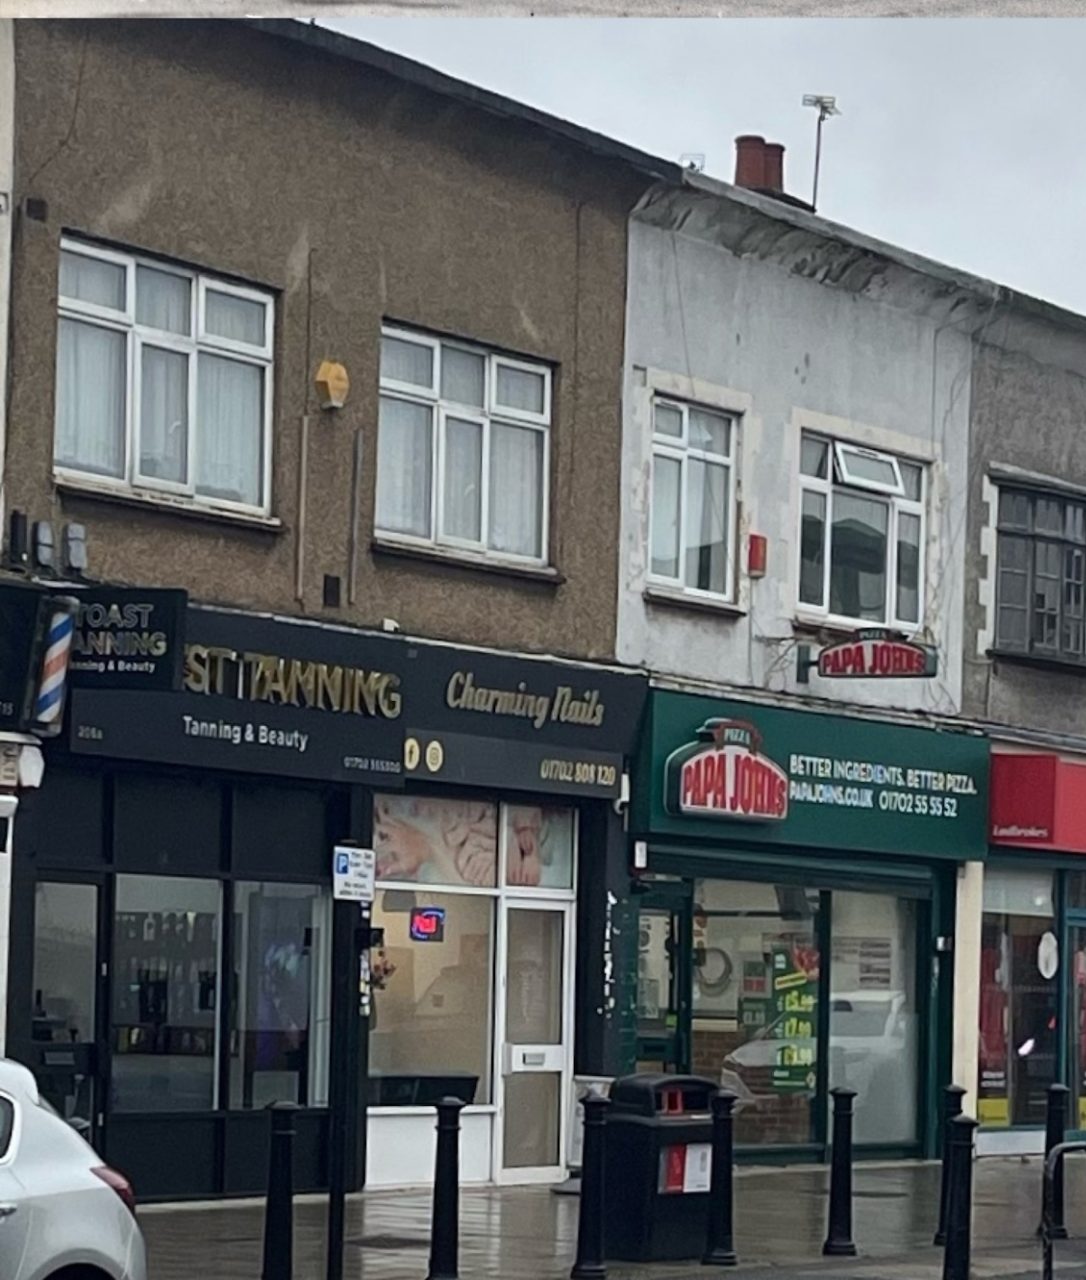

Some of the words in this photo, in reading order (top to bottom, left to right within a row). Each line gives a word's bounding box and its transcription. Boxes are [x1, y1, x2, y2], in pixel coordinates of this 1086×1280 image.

[72, 631, 167, 657] ANNING
[118, 660, 155, 673] Beauty
[823, 644, 865, 673] PAPA
[243, 652, 400, 719] TANNING
[447, 671, 549, 729] Charming
[551, 686, 604, 726] Nails
[183, 716, 241, 744] Tanning
[244, 723, 254, 741] &
[258, 725, 308, 752] Beauty
[723, 727, 751, 745] PIZZA
[540, 758, 572, 782] 01702
[790, 754, 832, 778] BETTER
[834, 760, 905, 787] INGREDIENTS.
[907, 768, 944, 791] BETTER
[683, 754, 727, 810] PAPA
[730, 754, 786, 817] JOHNS
[879, 790, 912, 812] 01702
[915, 795, 928, 814] 55
[929, 798, 943, 816] 55
[944, 798, 958, 817] 52
[993, 824, 1049, 838] Ladbrokes
